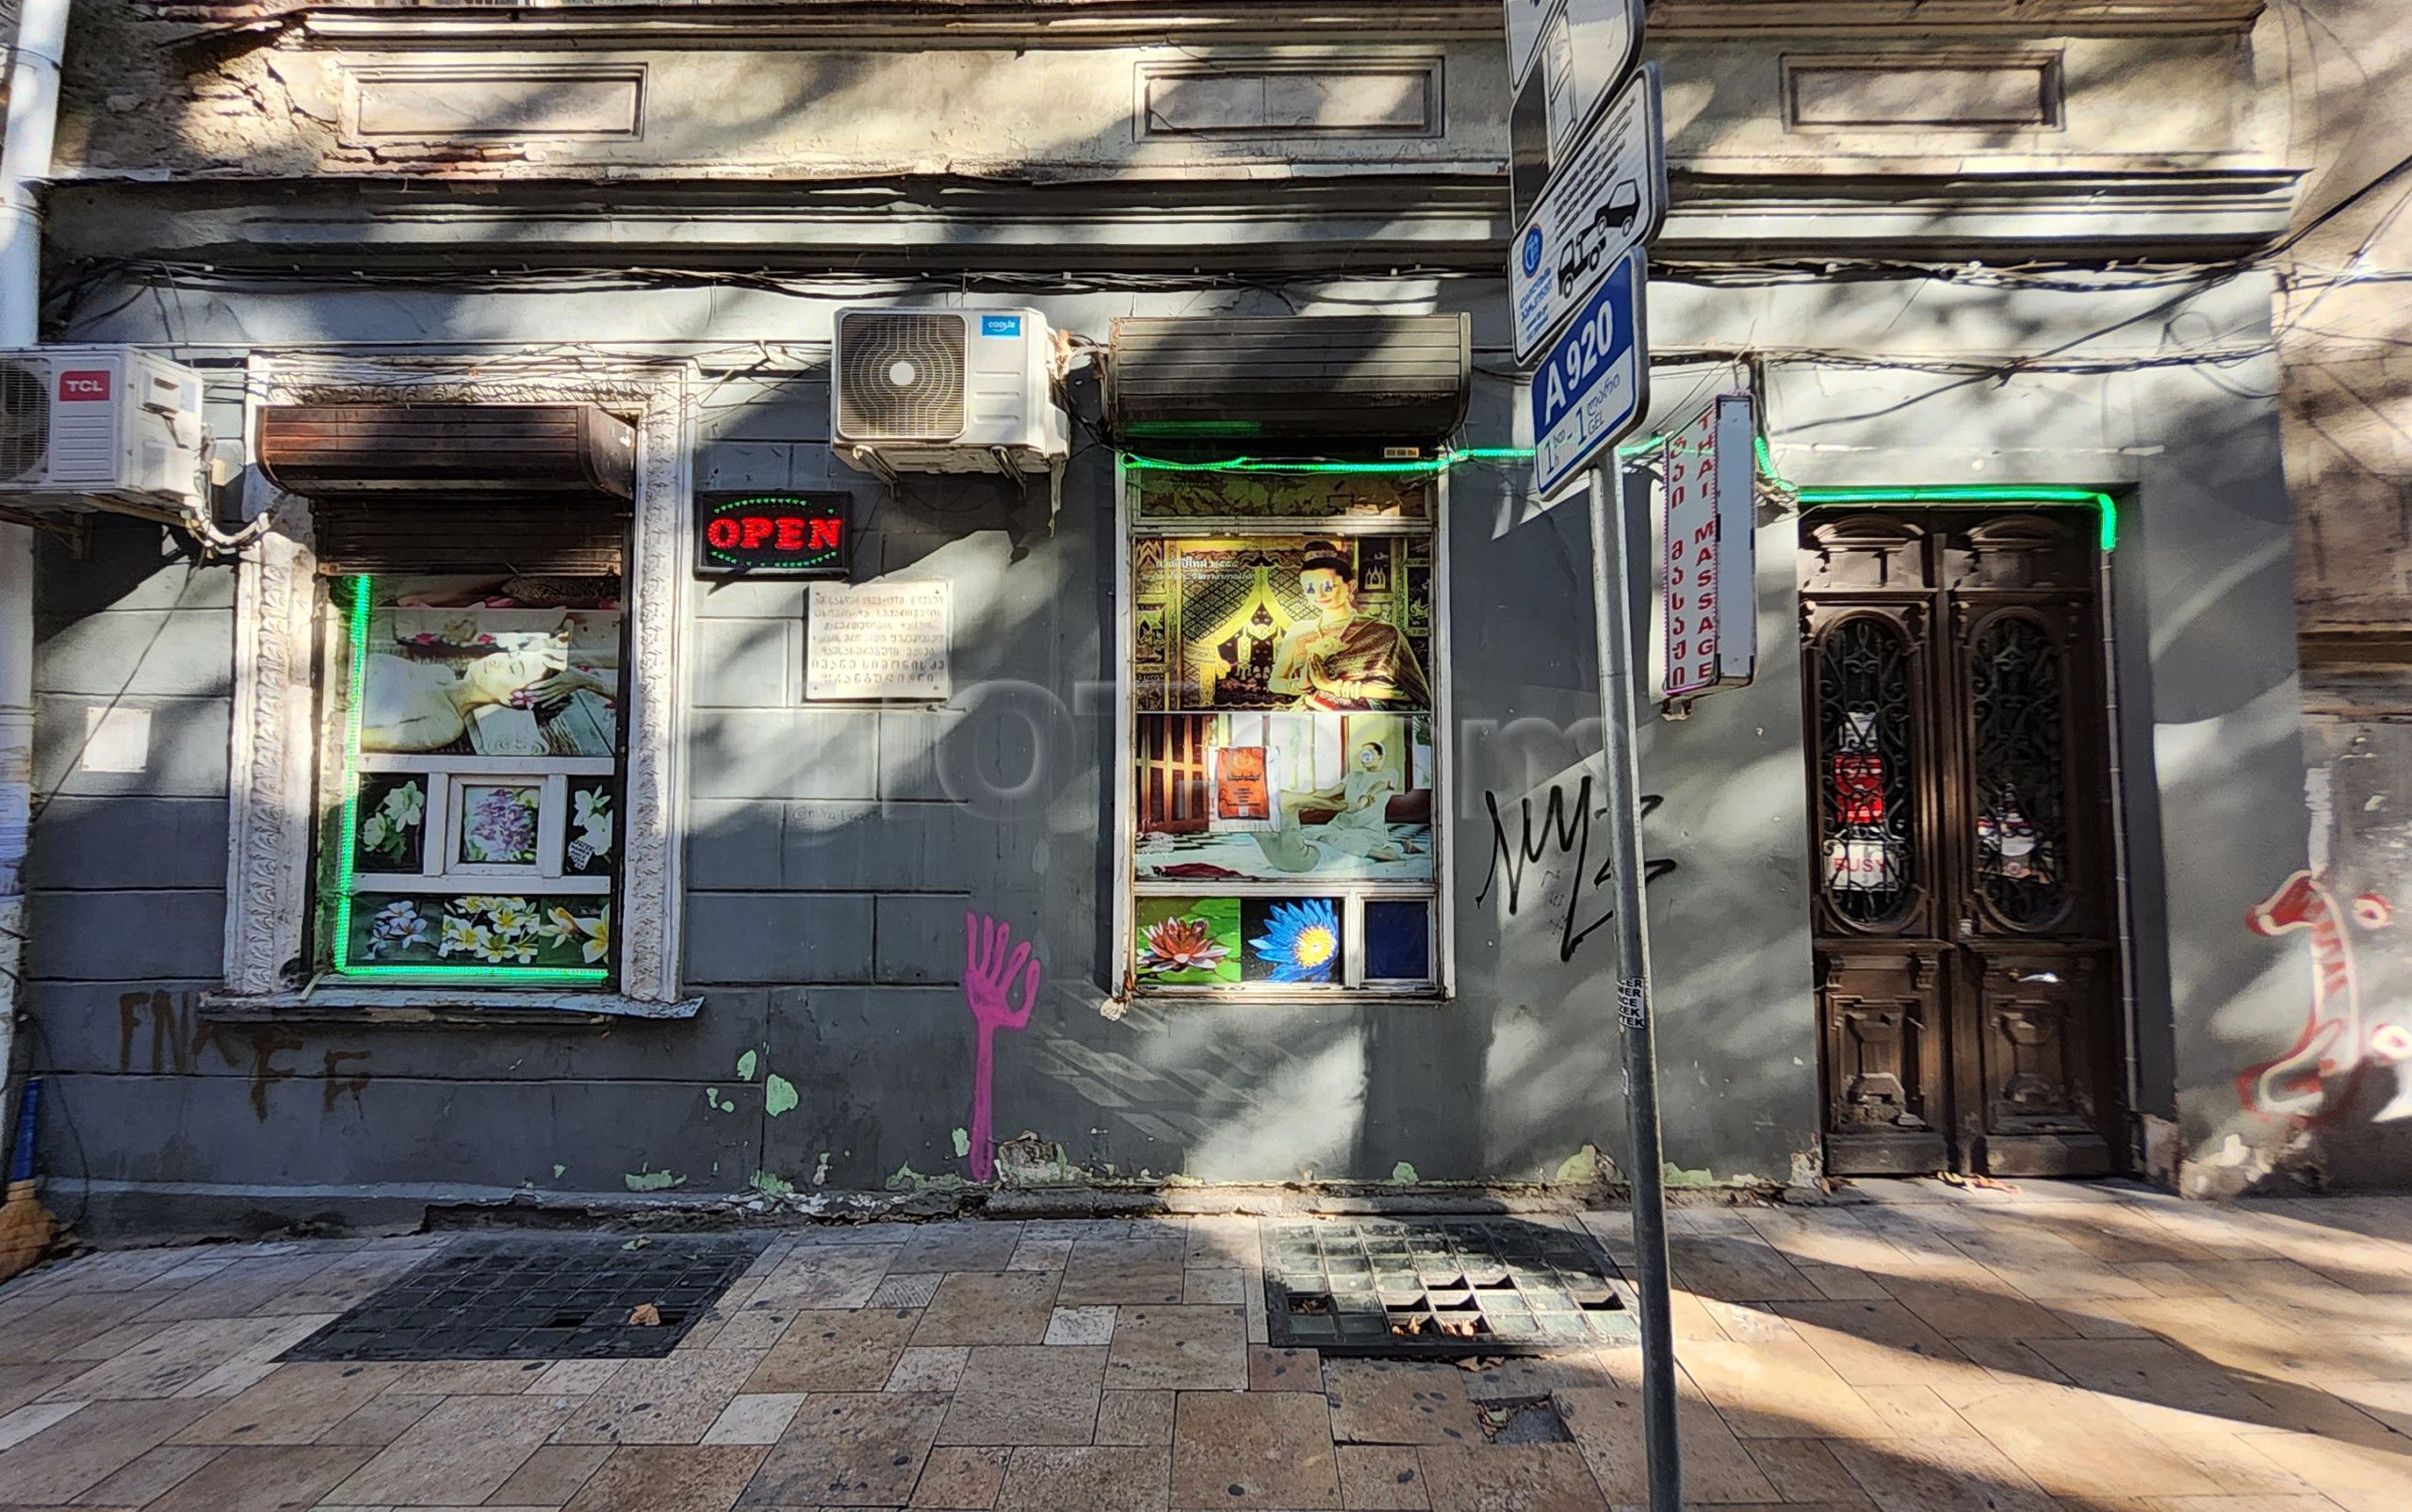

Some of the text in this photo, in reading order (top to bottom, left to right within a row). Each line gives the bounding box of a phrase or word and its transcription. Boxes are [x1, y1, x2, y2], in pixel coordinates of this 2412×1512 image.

[65, 380, 103, 392] TCL
[1544, 442, 1555, 476] 1
[1575, 406, 1586, 448] 1
[1588, 413, 1605, 437] GEL
[1697, 411, 1714, 498] THAI
[708, 517, 843, 550] OPEN
[1670, 540, 1687, 687] მასაჟი
[1694, 521, 1715, 680] MASSAGE
[1833, 857, 1887, 874] BUSY
